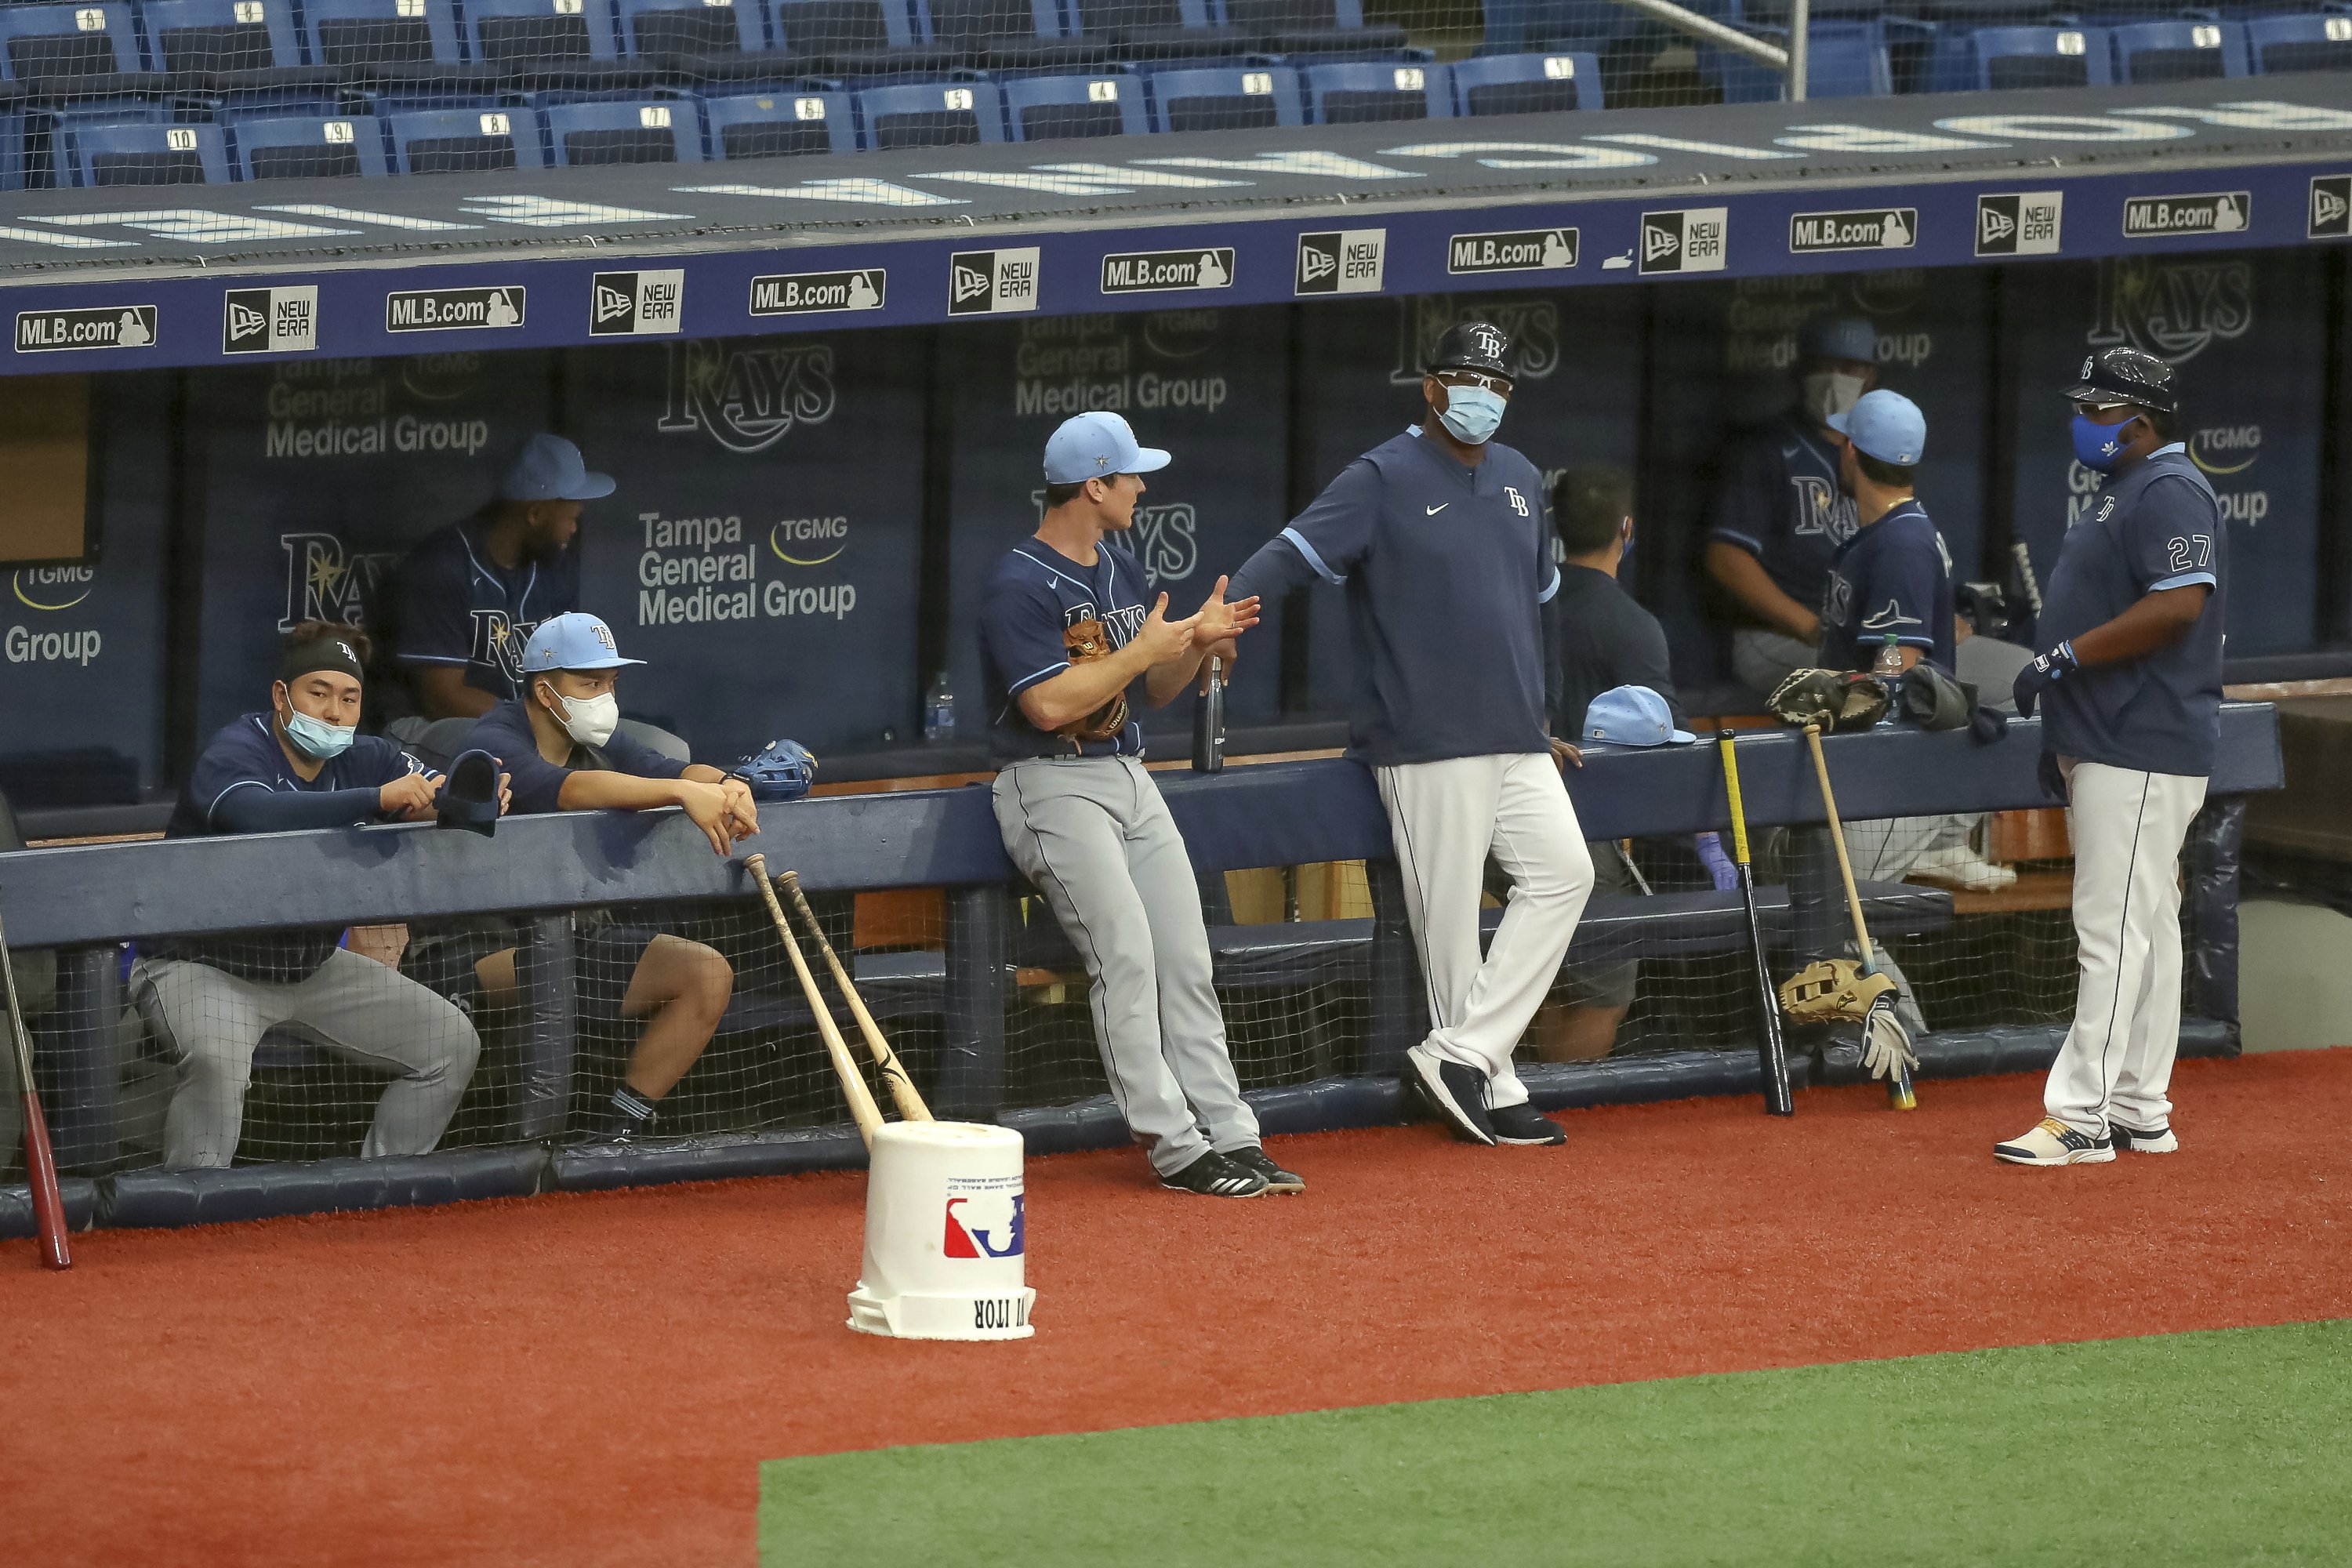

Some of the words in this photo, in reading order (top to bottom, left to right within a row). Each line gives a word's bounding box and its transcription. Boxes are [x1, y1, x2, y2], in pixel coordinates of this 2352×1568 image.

[334, 124, 343, 140] 9
[492, 116, 499, 132] 8
[173, 130, 190, 147] 10
[2026, 206, 2055, 222] NEW
[2129, 204, 2212, 230] MLB.com
[1690, 223, 1720, 240] NEW
[1795, 220, 1879, 245] MLB.com
[2024, 225, 2053, 240] ERA
[1347, 244, 1377, 260] NEW
[1454, 240, 1540, 267] MLB.com
[1690, 240, 1719, 257] ERA
[1001, 262, 1032, 278] NEW
[1108, 260, 1195, 286] MLB.com
[1345, 261, 1377, 278] ERA
[644, 285, 676, 302] NEW
[757, 281, 845, 308] MLB.com
[1000, 280, 1030, 298] ERA
[277, 299, 310, 318] NEW
[393, 299, 484, 325] MLB.com
[642, 303, 674, 320] ERA
[22, 321, 115, 345] MLB.com
[277, 319, 309, 337] ERA
[1016, 336, 1129, 377] General
[1476, 332, 1500, 358] TB
[1876, 332, 1930, 367] oup
[267, 378, 387, 419] General
[657, 339, 836, 453] RAYS
[1015, 374, 1130, 416] Medical
[1137, 372, 1227, 412] Group
[267, 416, 387, 458] Medical
[394, 413, 488, 456] Group
[2200, 425, 2262, 450] TGMG
[1504, 487, 1529, 517] TB
[639, 512, 741, 553] Tampa
[781, 517, 848, 541] TGMG
[639, 544, 756, 588] General
[2168, 535, 2211, 572] 27
[639, 588, 756, 626] Medical
[764, 581, 857, 619] Group
[5, 625, 101, 666] Group
[590, 623, 615, 649] TB
